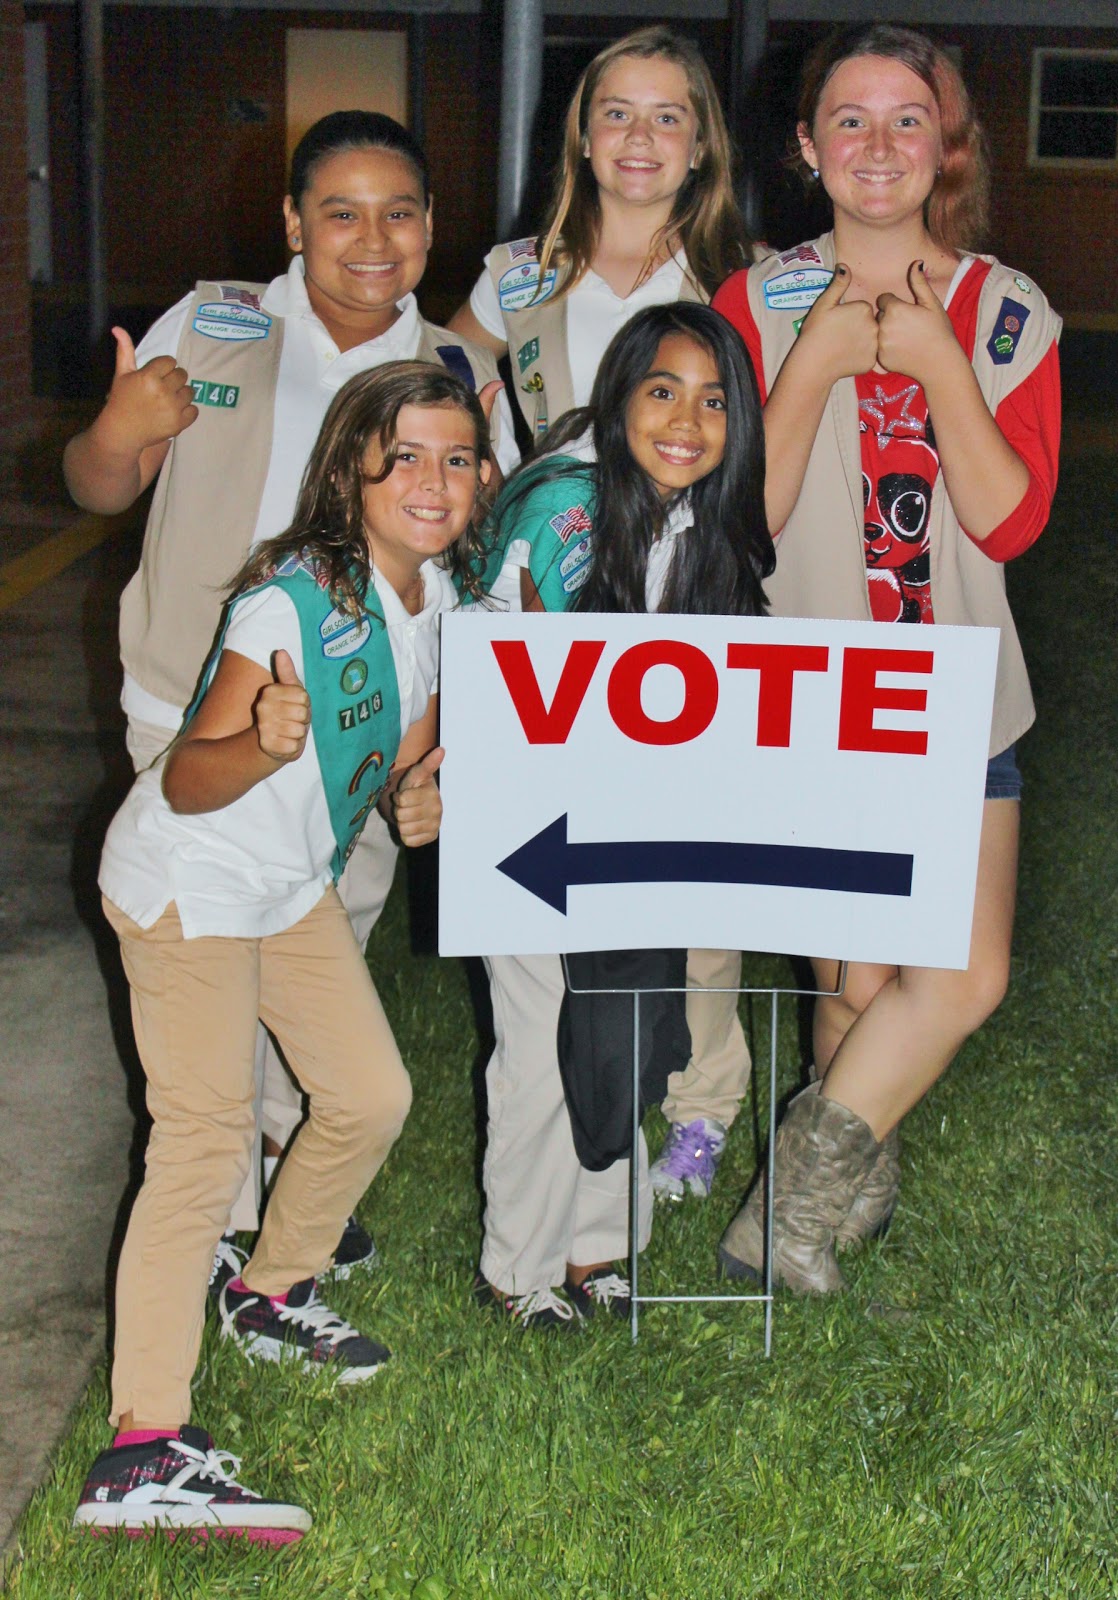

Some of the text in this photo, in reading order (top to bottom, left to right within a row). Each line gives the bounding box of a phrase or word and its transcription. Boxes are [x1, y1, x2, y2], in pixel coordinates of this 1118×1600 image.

[513, 273, 538, 285] SCOUTS
[768, 283, 786, 292] GIRL
[785, 279, 816, 288] SCOUTS
[504, 293, 526, 306] ORANGE
[772, 295, 803, 306] ORANGE
[199, 324, 262, 336] ORANGE COUNTY
[192, 383, 236, 405] 746
[562, 561, 576, 574] GIRL
[322, 614, 355, 636] GIRL SCOUTS
[327, 638, 350, 655] ORANGE
[491, 640, 934, 755] VOTE
[341, 694, 381, 728] 746
